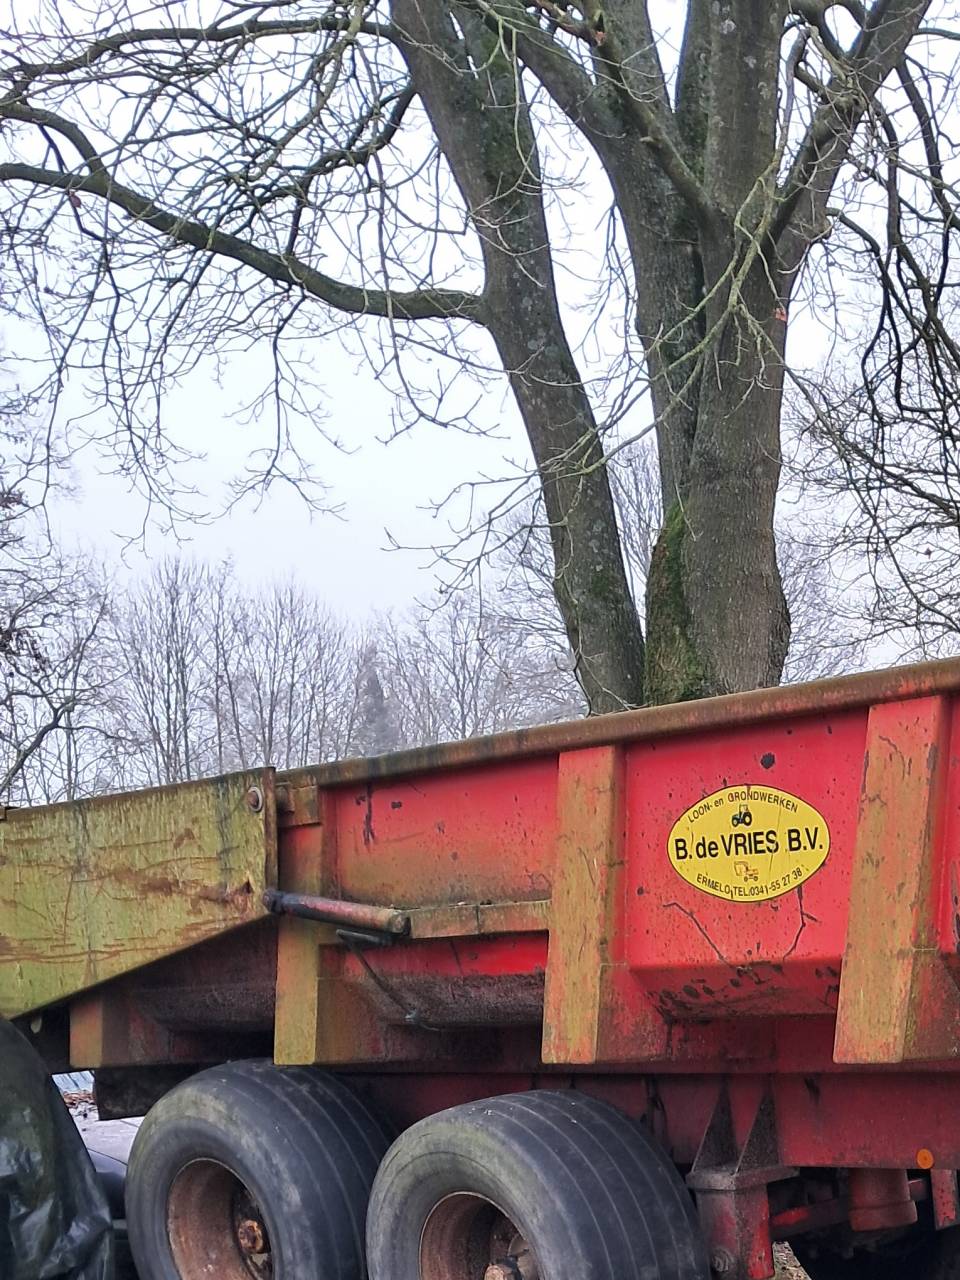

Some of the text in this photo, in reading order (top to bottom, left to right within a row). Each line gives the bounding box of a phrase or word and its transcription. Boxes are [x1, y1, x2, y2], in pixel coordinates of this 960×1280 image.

[688, 791, 798, 823] LOON- en GRONDWERKEN
[675, 827, 823, 860] B. de VRIES B.V.
[782, 874, 792, 886] 27
[792, 867, 803, 880] 38
